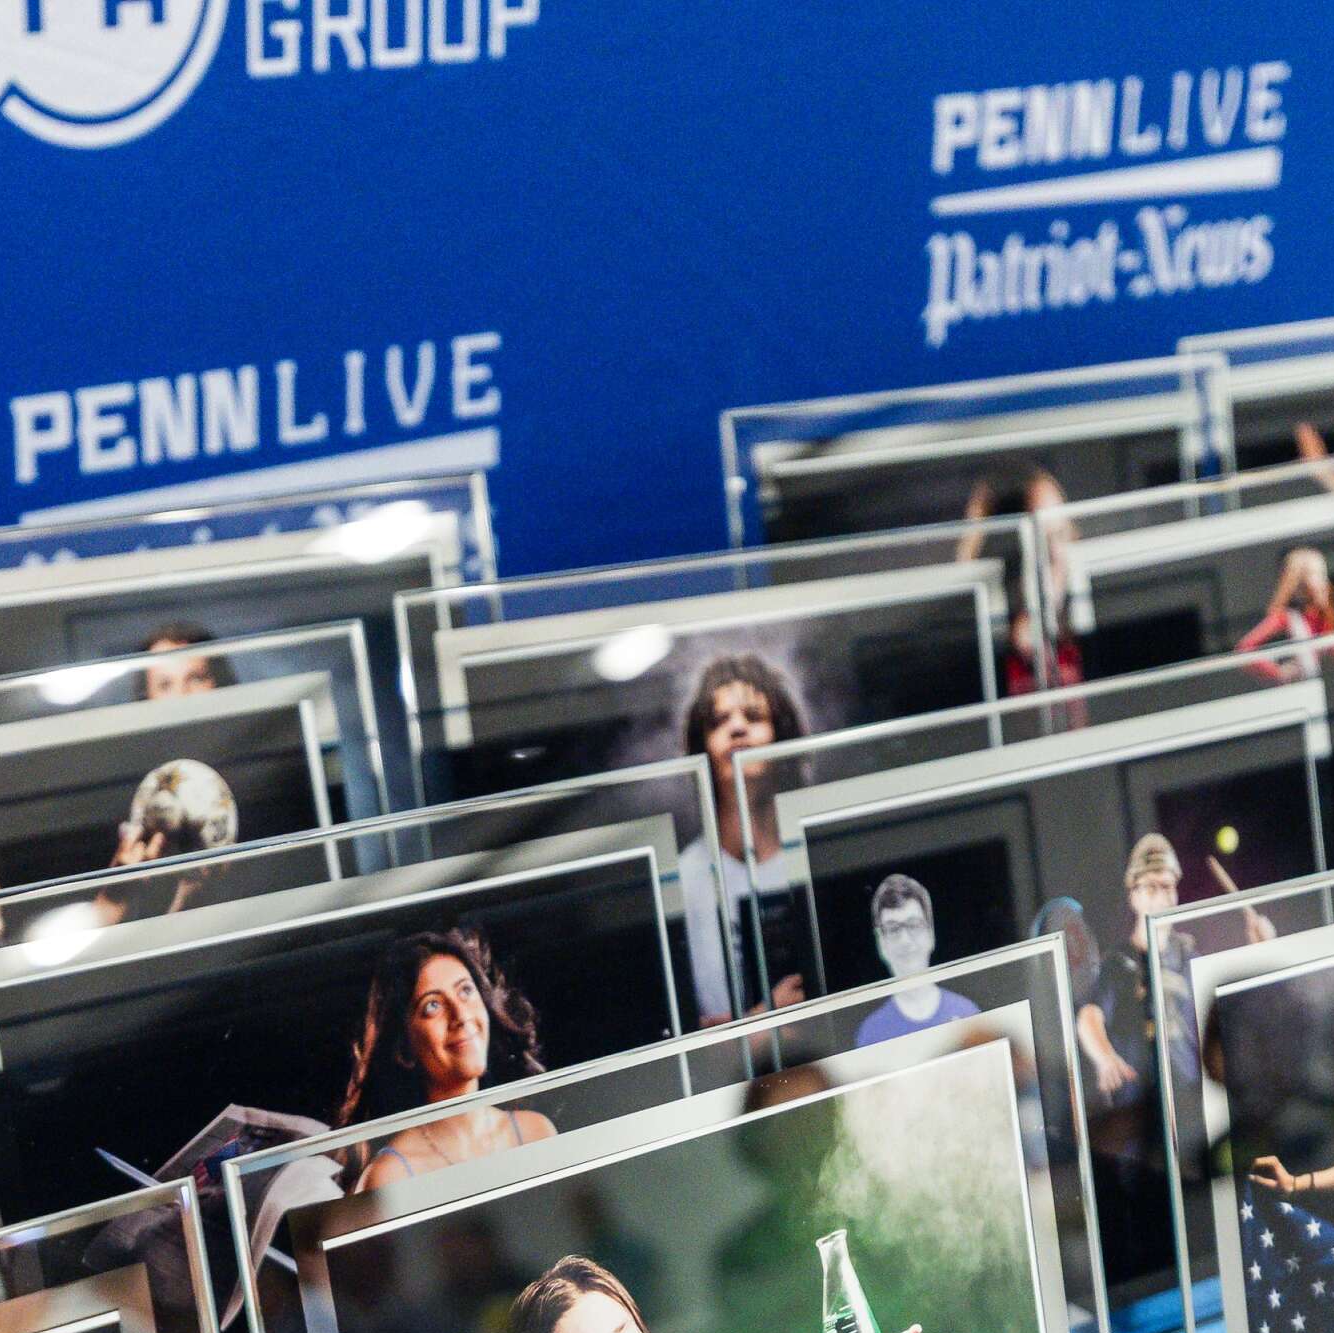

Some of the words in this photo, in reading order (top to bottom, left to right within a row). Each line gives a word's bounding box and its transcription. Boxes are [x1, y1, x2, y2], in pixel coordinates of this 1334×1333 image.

[246, 0, 541, 79] GROUP
[931, 61, 1292, 175] PENNLIVE
[921, 205, 1275, 350] Patriot-News
[10, 331, 503, 485] PENNLIVE
